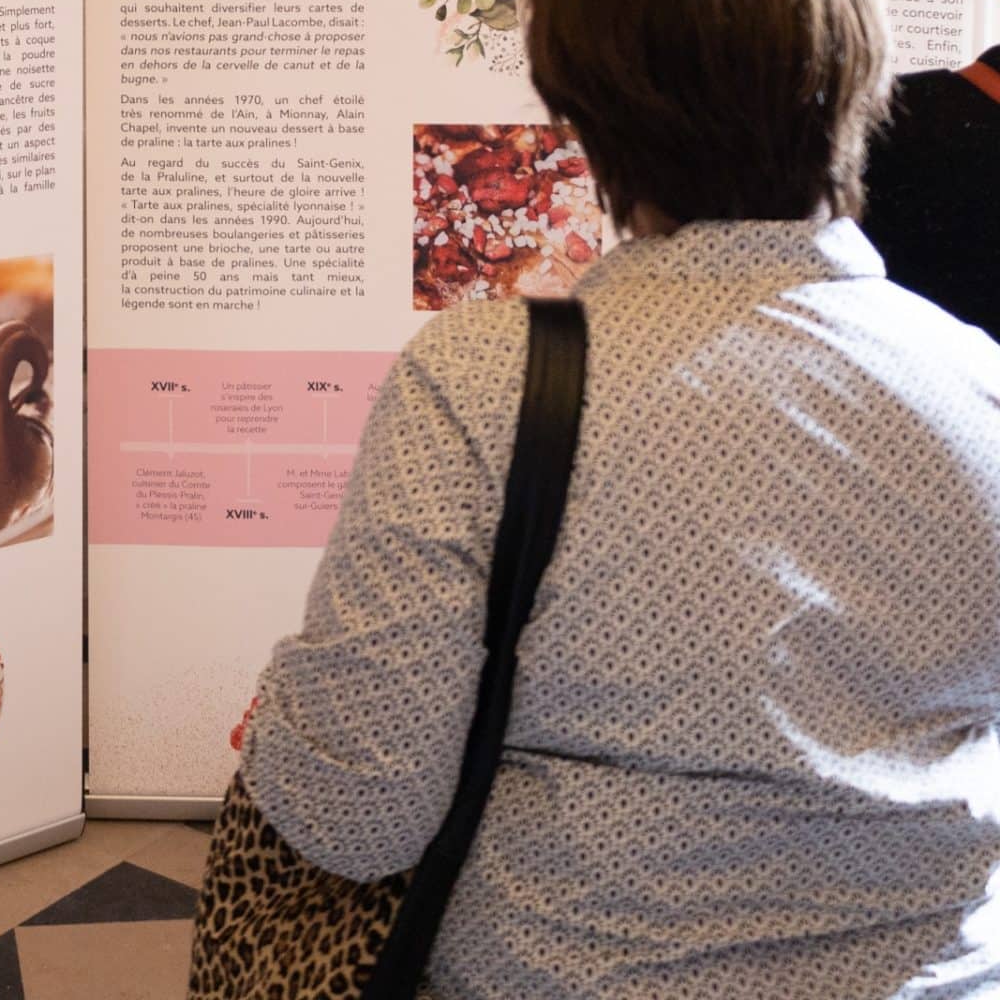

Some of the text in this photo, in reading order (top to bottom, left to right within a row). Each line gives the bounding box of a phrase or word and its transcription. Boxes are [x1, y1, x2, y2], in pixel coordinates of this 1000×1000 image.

[10, 19, 30, 33] plus
[34, 18, 56, 30] fort,
[120, 94, 148, 104] Dans
[158, 94, 174, 104] les
[184, 94, 224, 105] années
[234, 94, 264, 106] 1970,
[298, 94, 324, 104] chef
[332, 94, 365, 104] étoilé
[180, 384, 191, 392] s.
